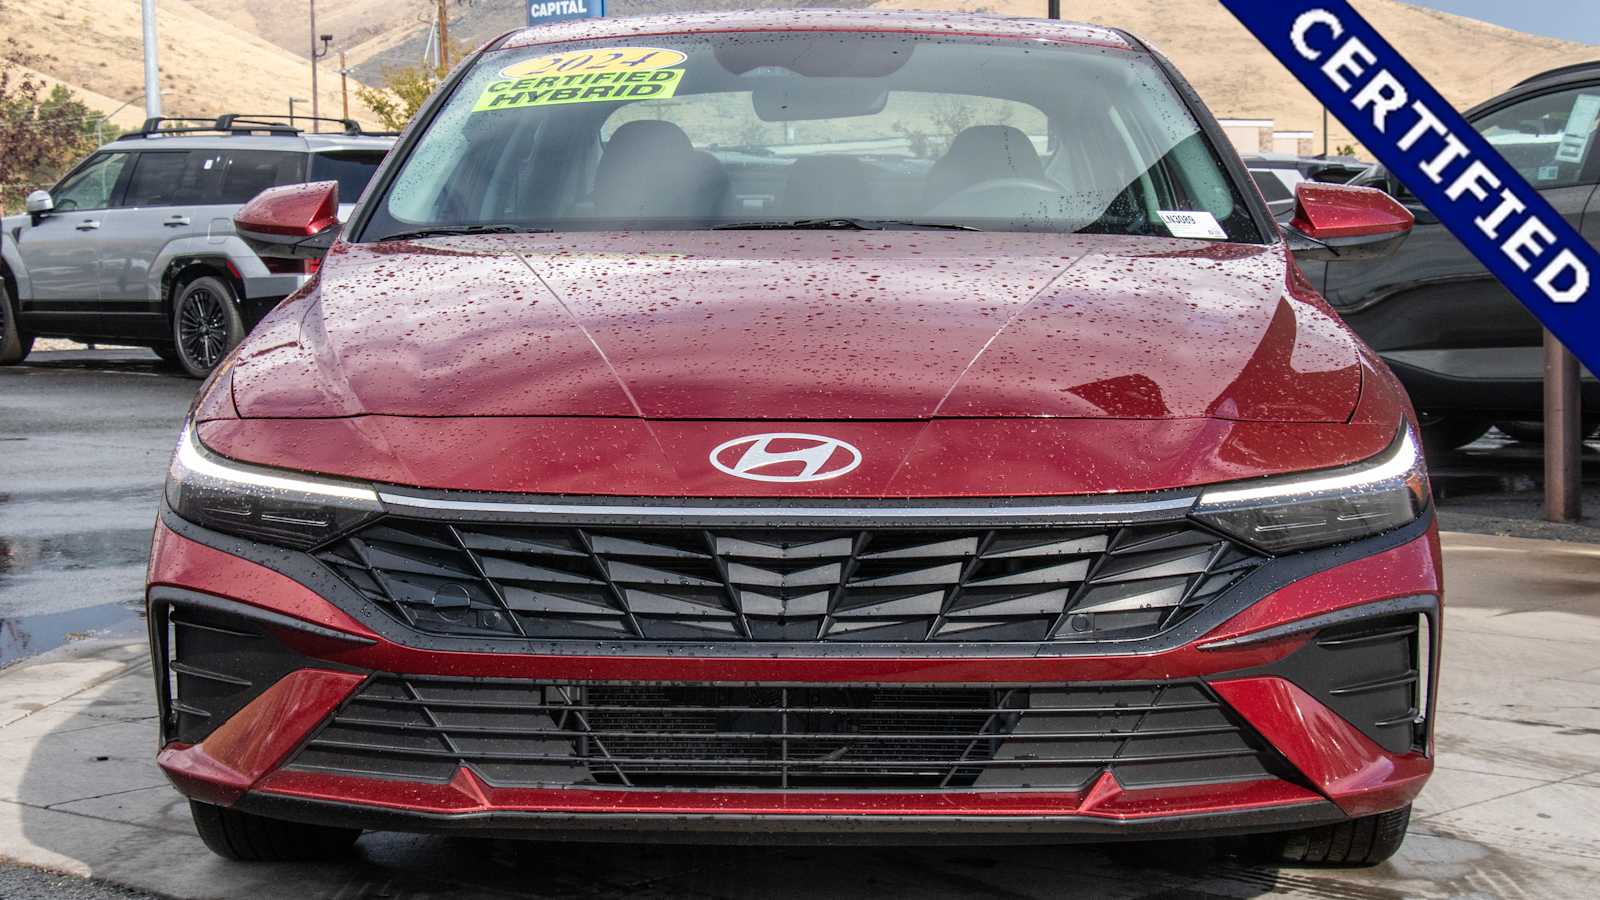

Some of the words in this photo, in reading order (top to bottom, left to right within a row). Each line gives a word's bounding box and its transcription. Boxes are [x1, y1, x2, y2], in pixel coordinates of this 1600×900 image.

[531, 0, 587, 18] CAPITAL
[528, 51, 659, 76] 2024
[488, 71, 675, 93] CERTIFIED
[488, 84, 663, 107] HYBRID
